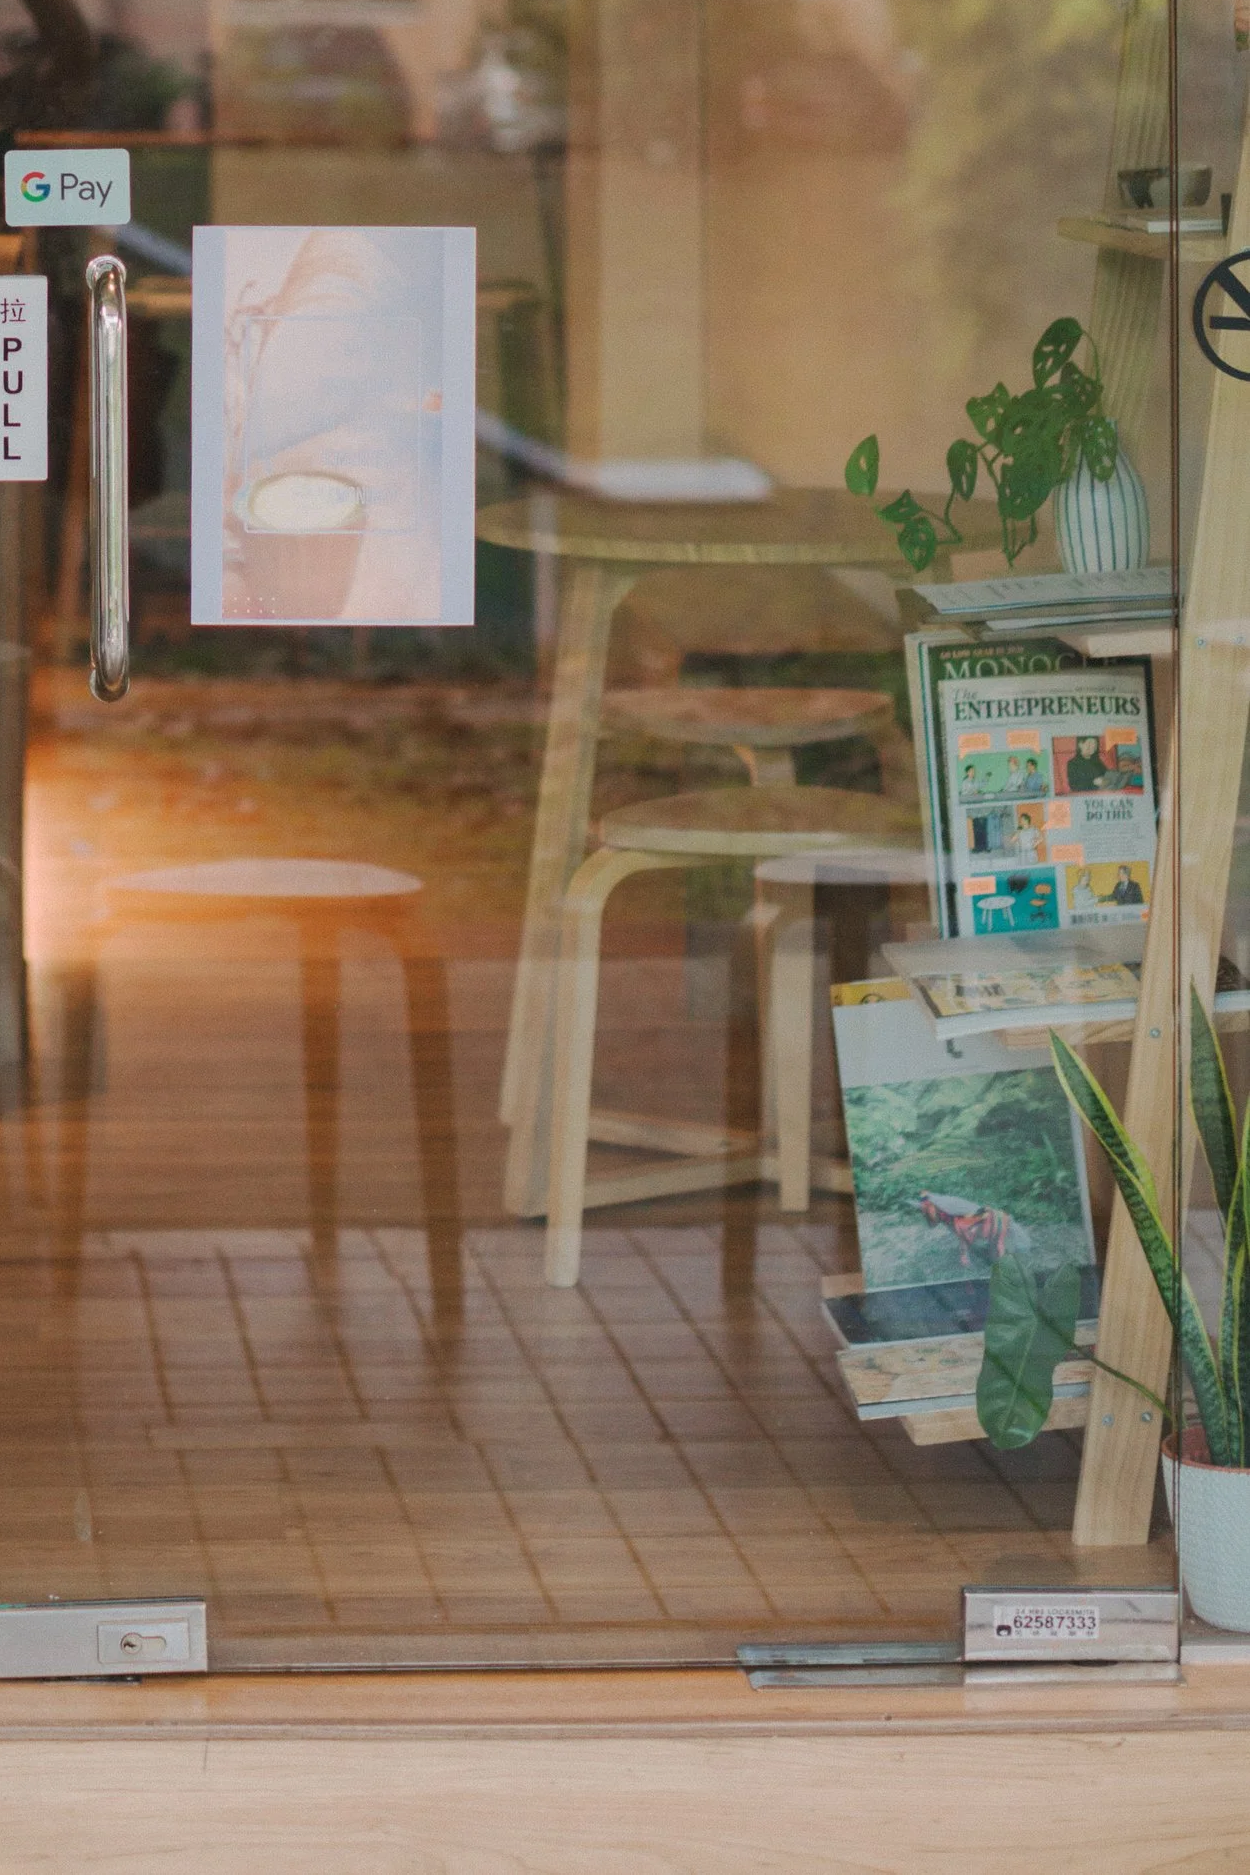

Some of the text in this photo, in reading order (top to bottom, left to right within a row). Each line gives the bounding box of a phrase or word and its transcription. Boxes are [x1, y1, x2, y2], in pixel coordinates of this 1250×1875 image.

[21, 171, 113, 208] G Pay
[0, 298, 26, 324] 拉
[3, 337, 23, 461] PULL
[953, 694, 1141, 722] ENTREPRENEURS
[1013, 1616, 1097, 1629] 62587333
